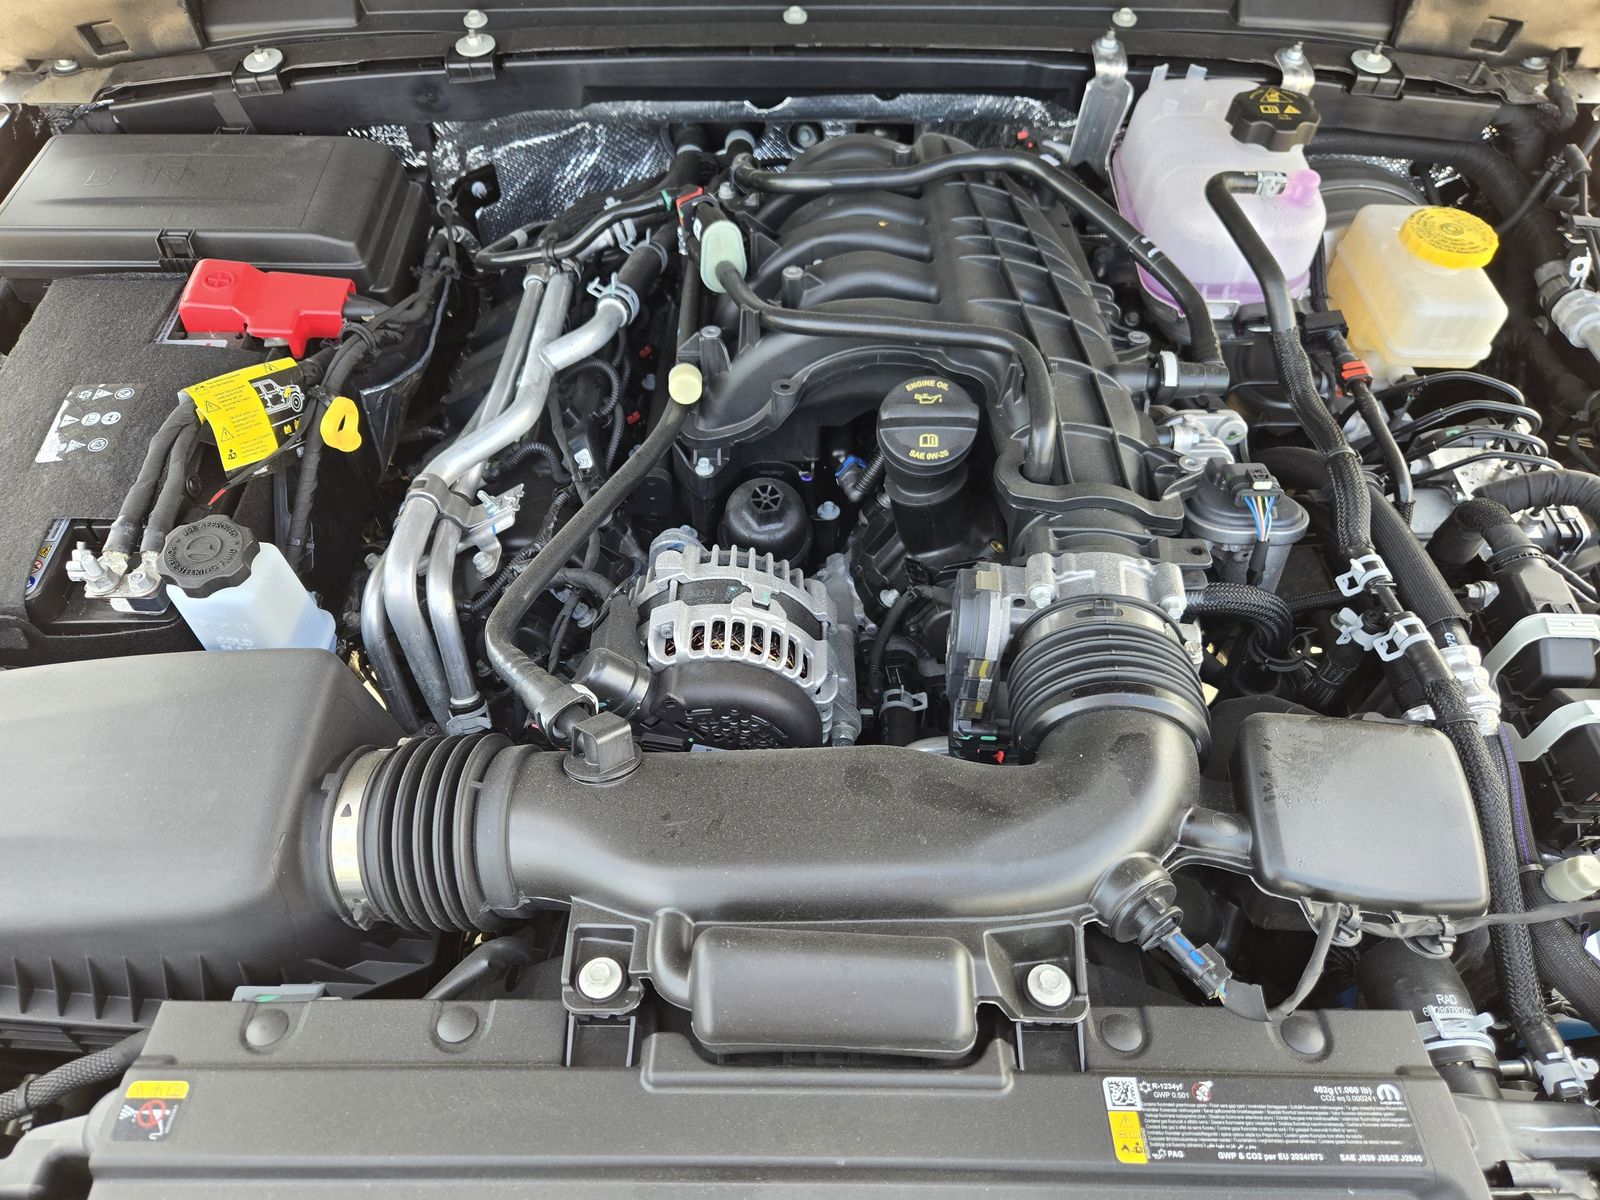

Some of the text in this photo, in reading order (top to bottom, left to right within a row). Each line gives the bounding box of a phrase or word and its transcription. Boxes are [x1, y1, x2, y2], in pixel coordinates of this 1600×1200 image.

[905, 380, 949, 392] ENGINE OIL
[908, 449, 949, 460] SAE 0W-20
[201, 521, 239, 537] APPROVED
[1435, 994, 1458, 1005] RAD
[1151, 1082, 1183, 1092] R-1234yf
[1167, 1150, 1185, 1159] PAG
[1217, 1152, 1237, 1160] GWP
[1246, 1152, 1263, 1161] CO2
[1264, 1153, 1277, 1162] per
[1278, 1153, 1289, 1161] EU
[1340, 1154, 1357, 1162] SAE
